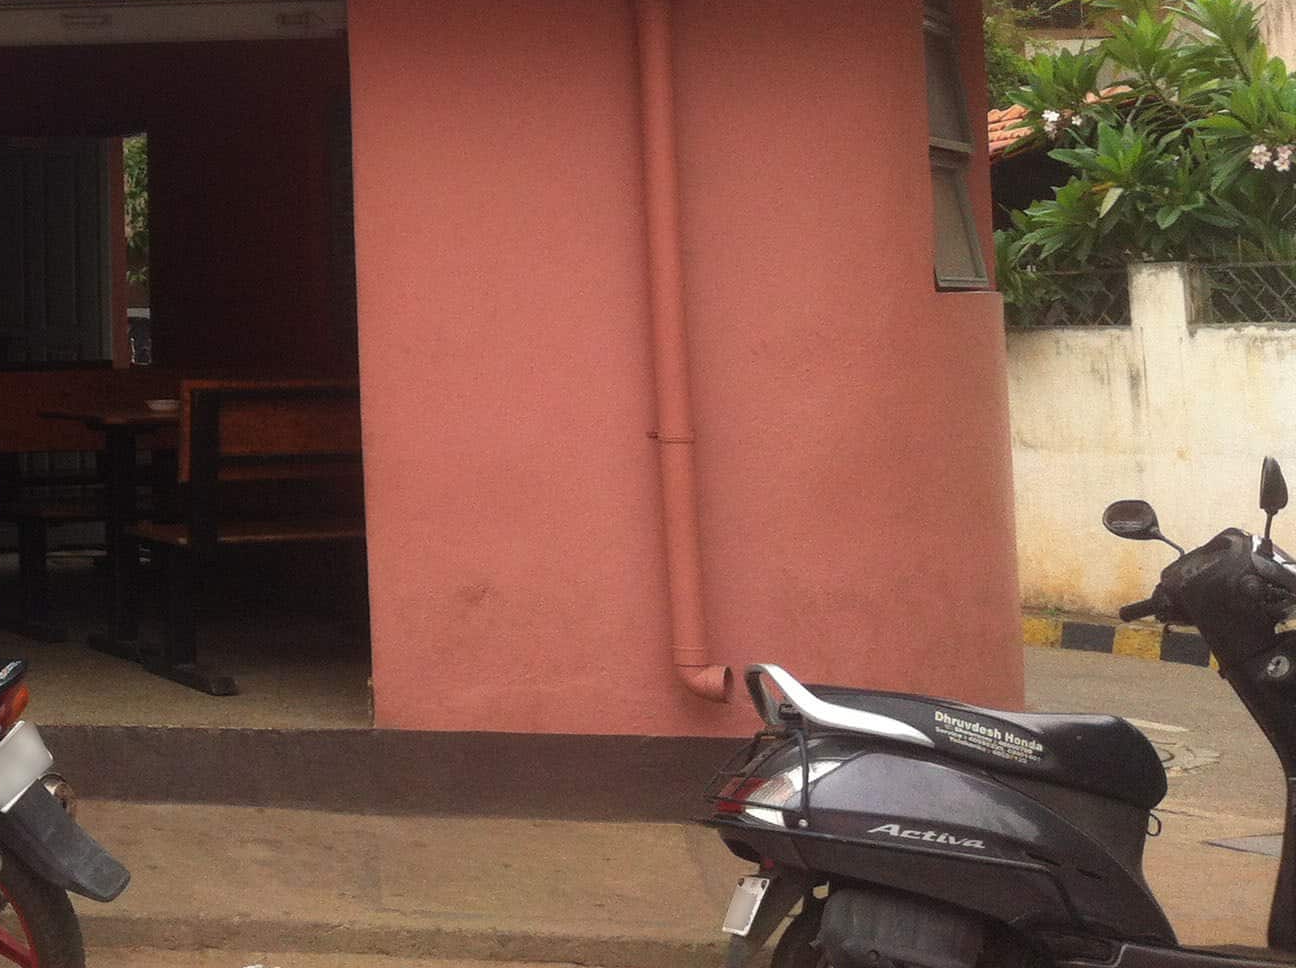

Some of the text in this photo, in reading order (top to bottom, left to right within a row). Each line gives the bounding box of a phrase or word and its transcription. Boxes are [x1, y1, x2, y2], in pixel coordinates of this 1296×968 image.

[934, 710, 1002, 740] Dhruvdesh
[1004, 732, 1044, 752] Honda
[867, 822, 986, 849] Activa
